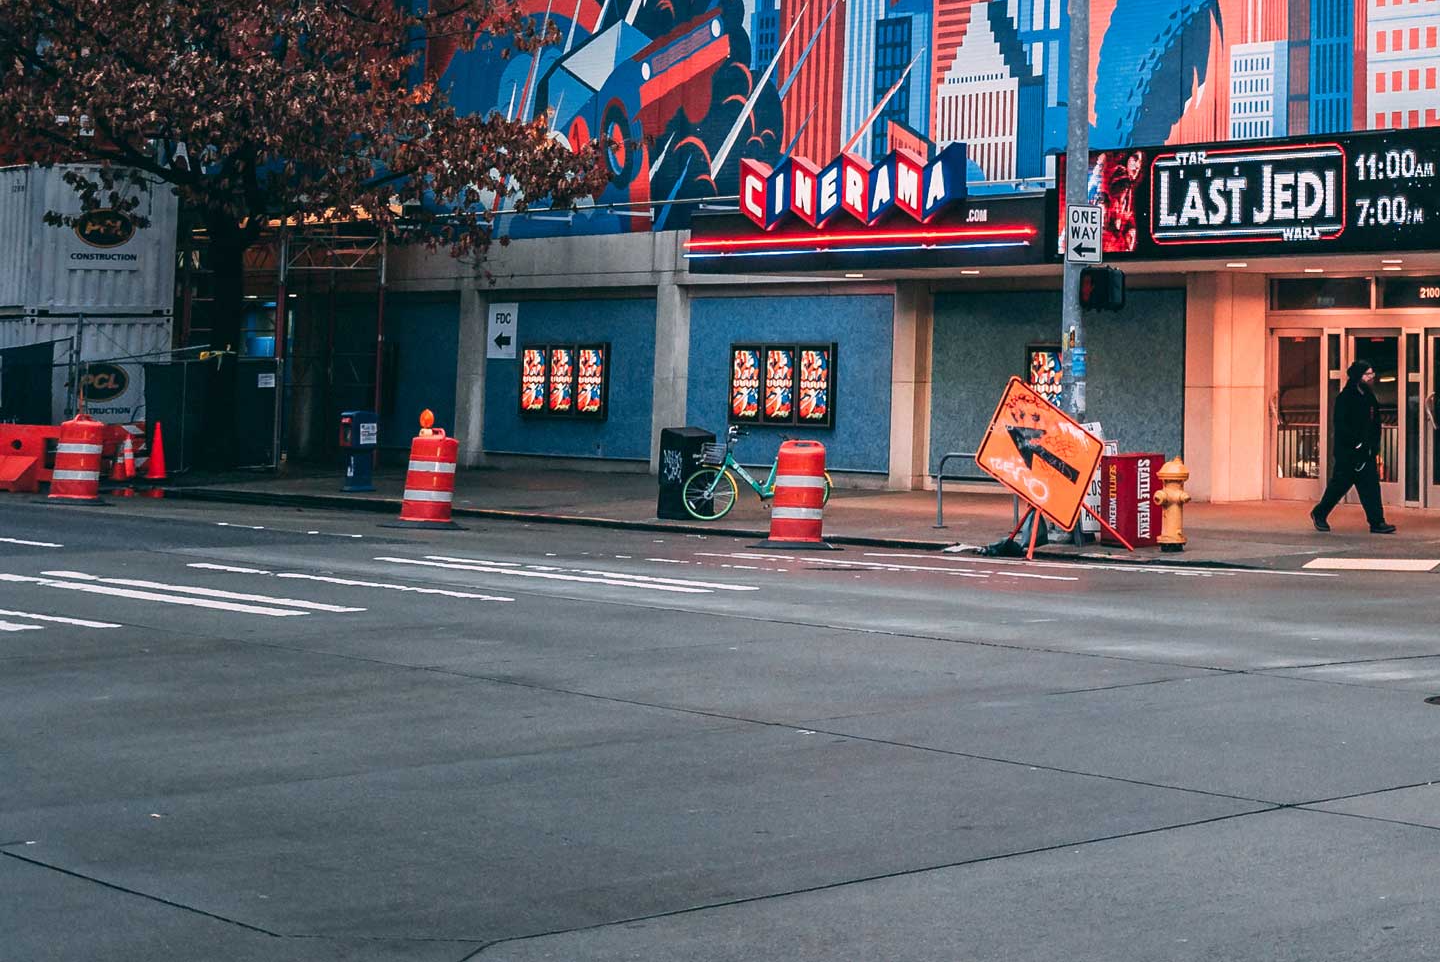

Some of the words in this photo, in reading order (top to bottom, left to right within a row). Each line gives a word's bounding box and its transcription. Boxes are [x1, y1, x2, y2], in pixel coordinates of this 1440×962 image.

[1176, 151, 1208, 165] STAR
[1355, 149, 1436, 181] 11:00AM
[744, 160, 947, 219] CINERAMA
[1159, 170, 1248, 227] LAST
[1253, 164, 1337, 225] JEDI
[1072, 210, 1097, 225] ONE
[1355, 195, 1425, 227] 7:00PM
[1071, 226, 1098, 240] WAY
[1282, 225, 1321, 241] WARS
[70, 252, 138, 262] CONSTRUCTION
[1419, 287, 1440, 299] 2100
[495, 312, 512, 325] FDC
[64, 406, 131, 415] TRUCTION
[1138, 459, 1151, 500] SEATTLE
[1138, 500, 1151, 539] WEEKLY
